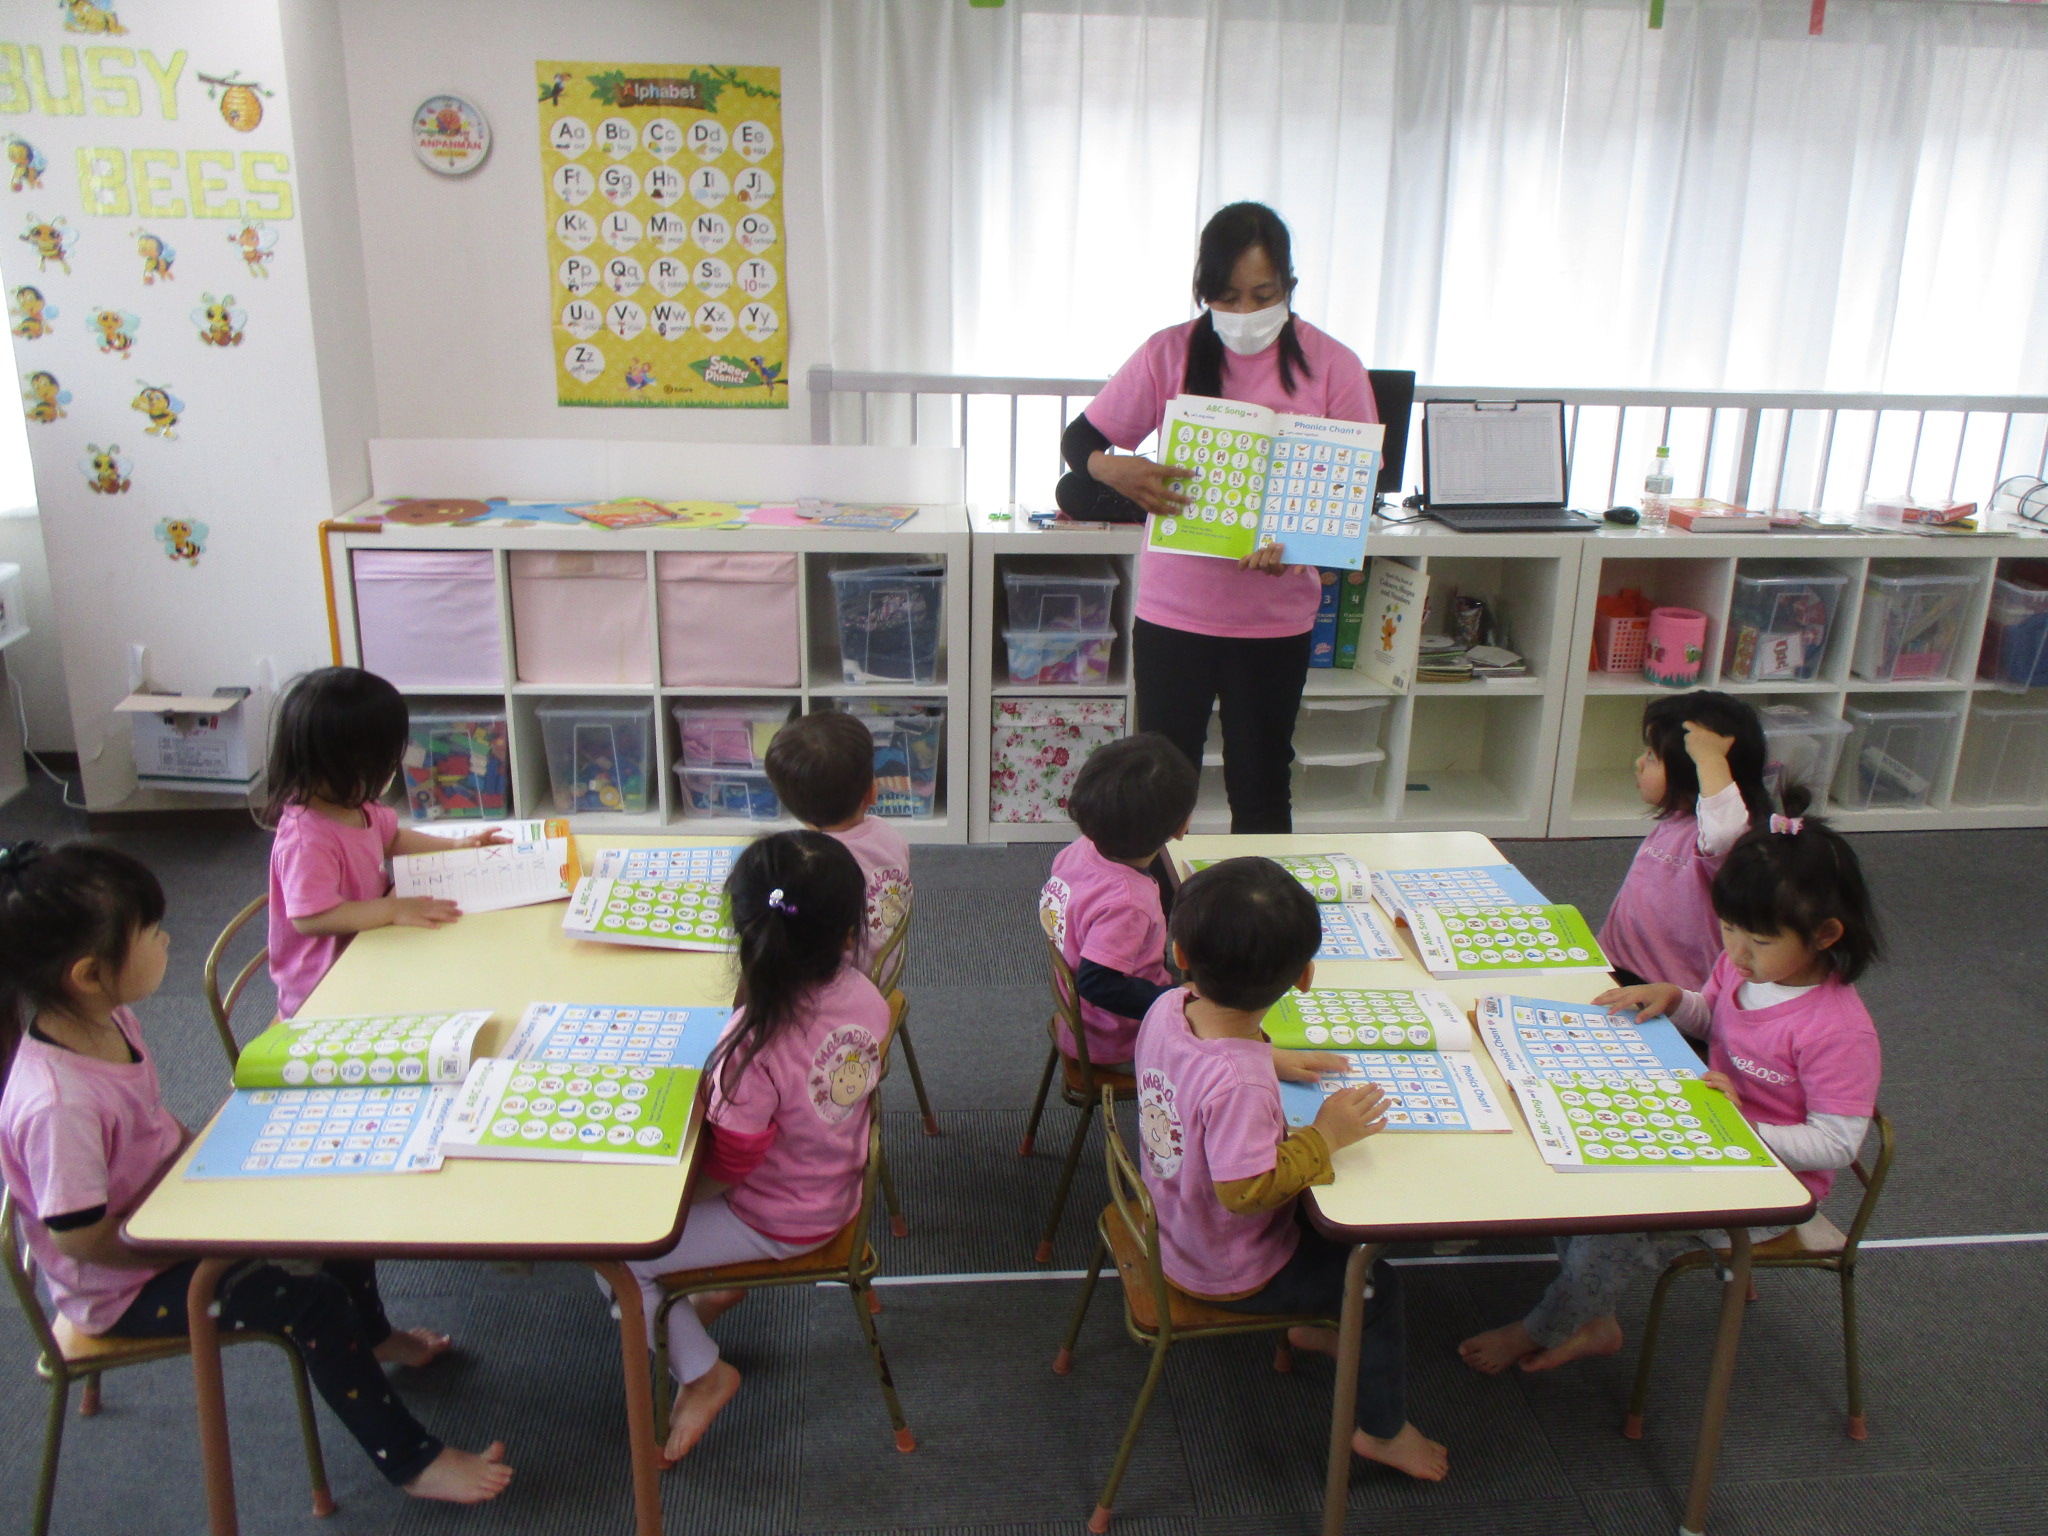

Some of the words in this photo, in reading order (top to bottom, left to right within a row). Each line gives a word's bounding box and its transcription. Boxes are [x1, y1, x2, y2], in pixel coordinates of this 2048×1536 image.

[622, 82, 697, 101] Alphabet
[559, 123, 585, 138] Aa
[606, 123, 630, 139] Bb
[651, 124, 675, 140] Cc
[695, 125, 720, 142] Dd
[743, 126, 764, 142] Ee
[76, 147, 294, 219] BEES
[565, 168, 580, 185] Ff
[606, 169, 632, 191] Gg
[653, 171, 677, 186] Hh
[746, 173, 761, 193] Jj
[565, 215, 587, 231] Kk
[614, 216, 628, 231] Ll
[651, 215, 683, 232] Mm
[698, 218, 724, 233] Nn
[743, 218, 769, 234] Oo
[568, 260, 591, 278] Pp
[611, 261, 639, 279] Qq
[660, 261, 678, 277] Rr
[702, 262, 721, 278] Ss
[750, 263, 766, 278] Tt
[570, 305, 594, 320] Uu
[615, 305, 637, 320] Vv
[654, 305, 686, 320] Ww
[703, 307, 726, 322] Xx
[748, 307, 770, 326] Yy
[576, 347, 593, 362] Zz
[709, 355, 749, 378] Speed
[704, 370, 744, 384] Phonics
[1225, 407, 1245, 417] Song
[1294, 421, 1327, 431] Phonics
[1329, 426, 1354, 434] Chant
[1324, 595, 1331, 604] 3
[1352, 595, 1360, 604] 4
[1415, 913, 1427, 929] Song
[1421, 932, 1433, 945] ABC
[1461, 1065, 1479, 1088] Phonics
[1474, 1089, 1491, 1107] Chant
[1531, 1099, 1545, 1118] Song
[1538, 1120, 1553, 1135] ABC
